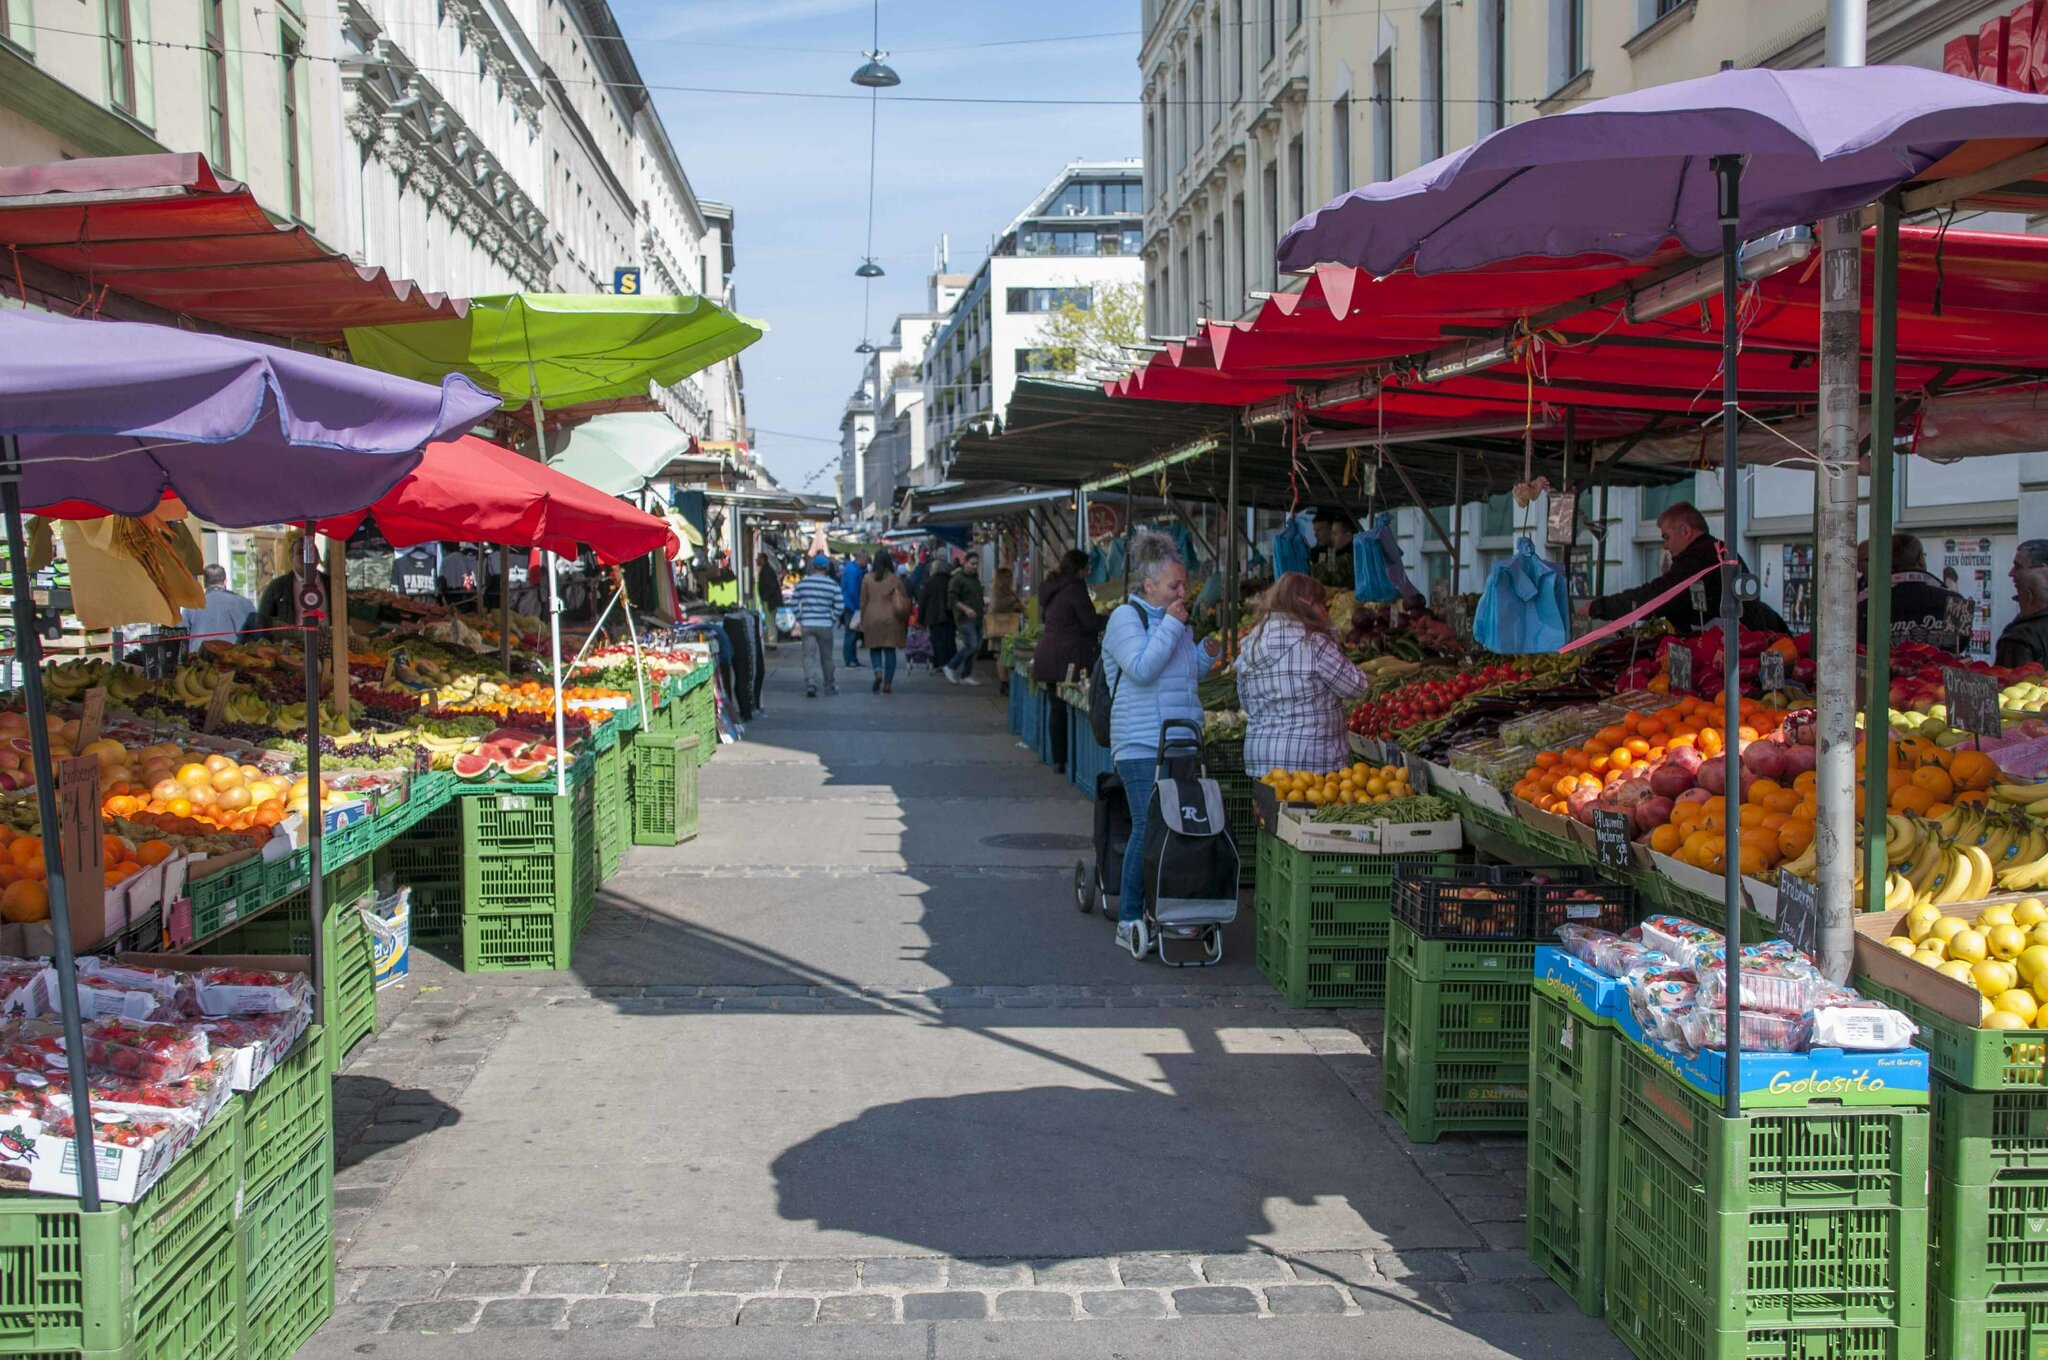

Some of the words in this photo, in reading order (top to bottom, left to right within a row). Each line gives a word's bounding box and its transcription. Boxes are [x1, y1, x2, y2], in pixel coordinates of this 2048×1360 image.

[620, 273, 636, 294] S
[403, 573, 435, 589] PARIS
[1181, 806, 1207, 822] R
[1546, 967, 1582, 1004] Golosito
[1768, 1068, 1885, 1096] Golosito
